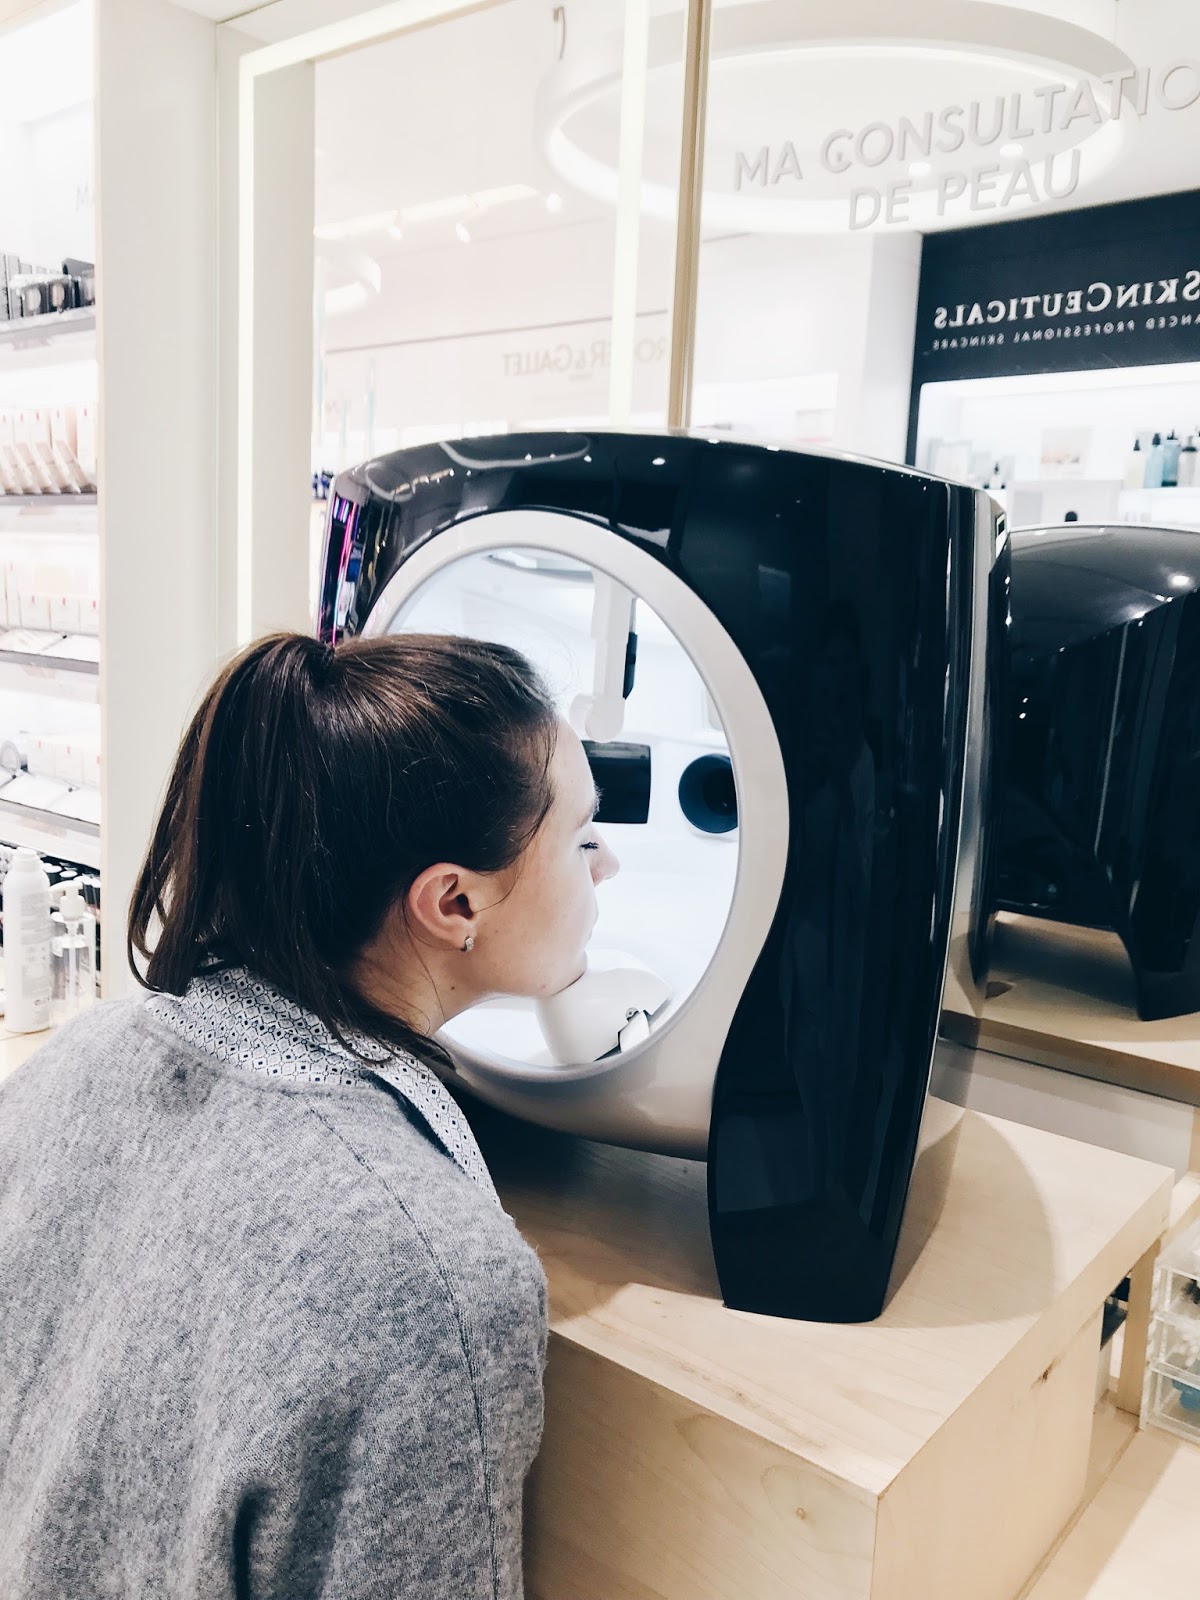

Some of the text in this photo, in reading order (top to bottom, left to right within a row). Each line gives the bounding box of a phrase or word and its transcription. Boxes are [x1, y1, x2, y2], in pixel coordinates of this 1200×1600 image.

[734, 58, 1200, 191] MA CONSULTATIO
[848, 148, 1082, 231] DE PEAU
